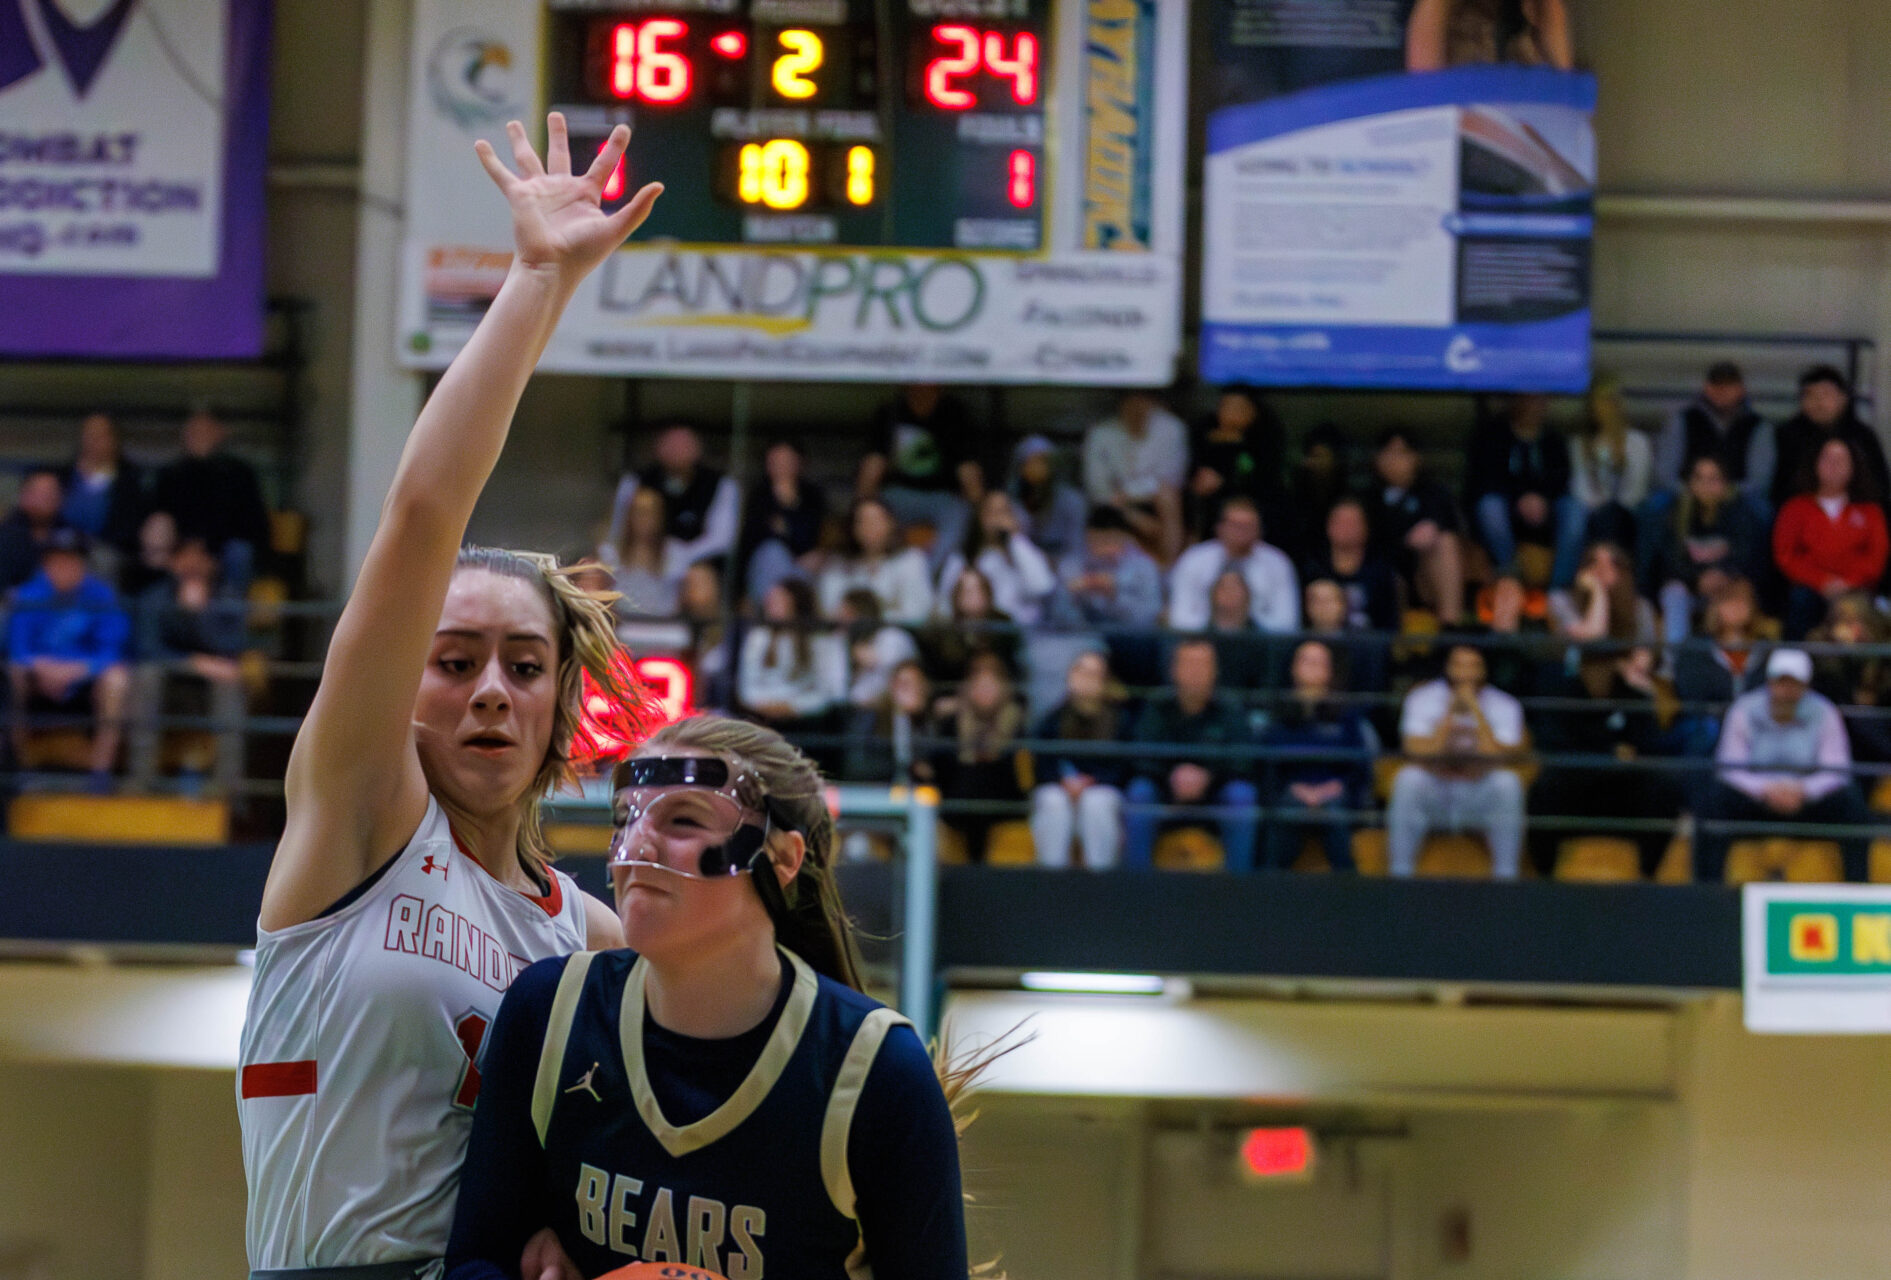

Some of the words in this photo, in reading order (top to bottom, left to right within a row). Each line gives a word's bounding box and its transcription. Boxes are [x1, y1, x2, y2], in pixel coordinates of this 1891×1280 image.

[609, 17, 692, 104] 16
[772, 28, 823, 100] 2
[924, 24, 1038, 110] 24
[738, 139, 812, 210] 10
[846, 145, 875, 206] 1
[1008, 149, 1036, 208] 1
[597, 253, 987, 332] LANDPRO
